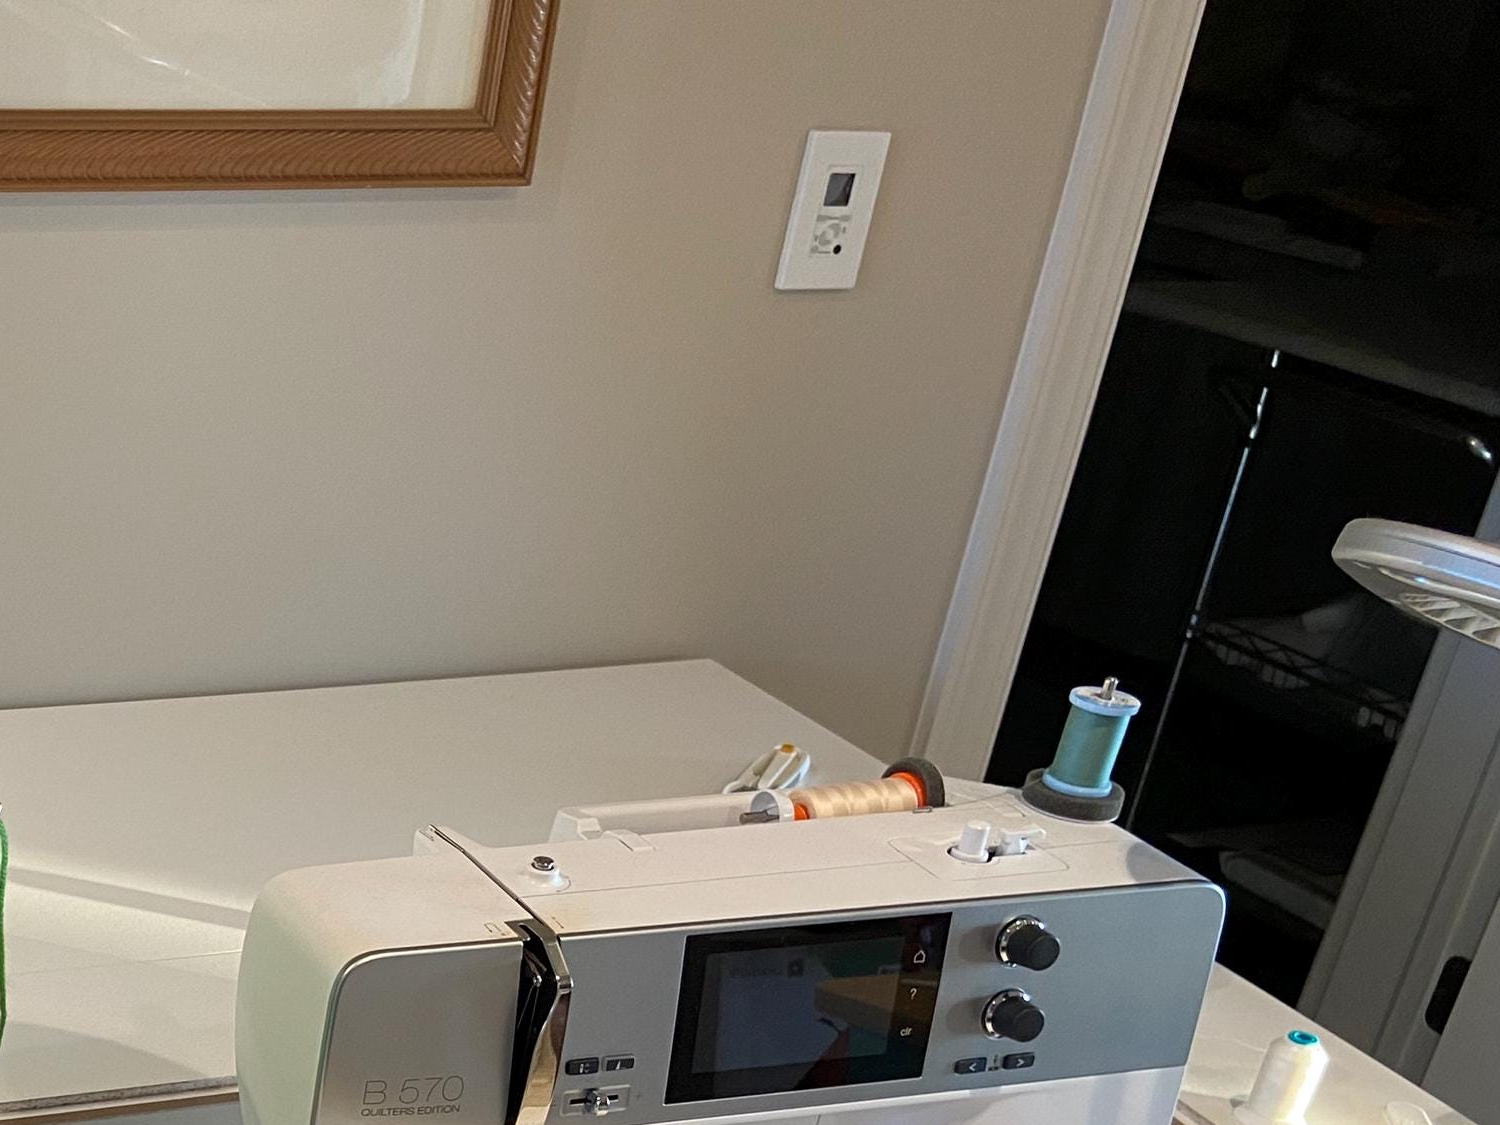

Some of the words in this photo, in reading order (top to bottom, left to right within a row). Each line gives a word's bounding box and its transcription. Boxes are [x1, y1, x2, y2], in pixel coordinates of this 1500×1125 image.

[362, 1079, 388, 1105] B
[398, 1075, 465, 1105] 570
[360, 1106, 416, 1117] QUILTERS
[417, 1104, 461, 1115] EDITION
